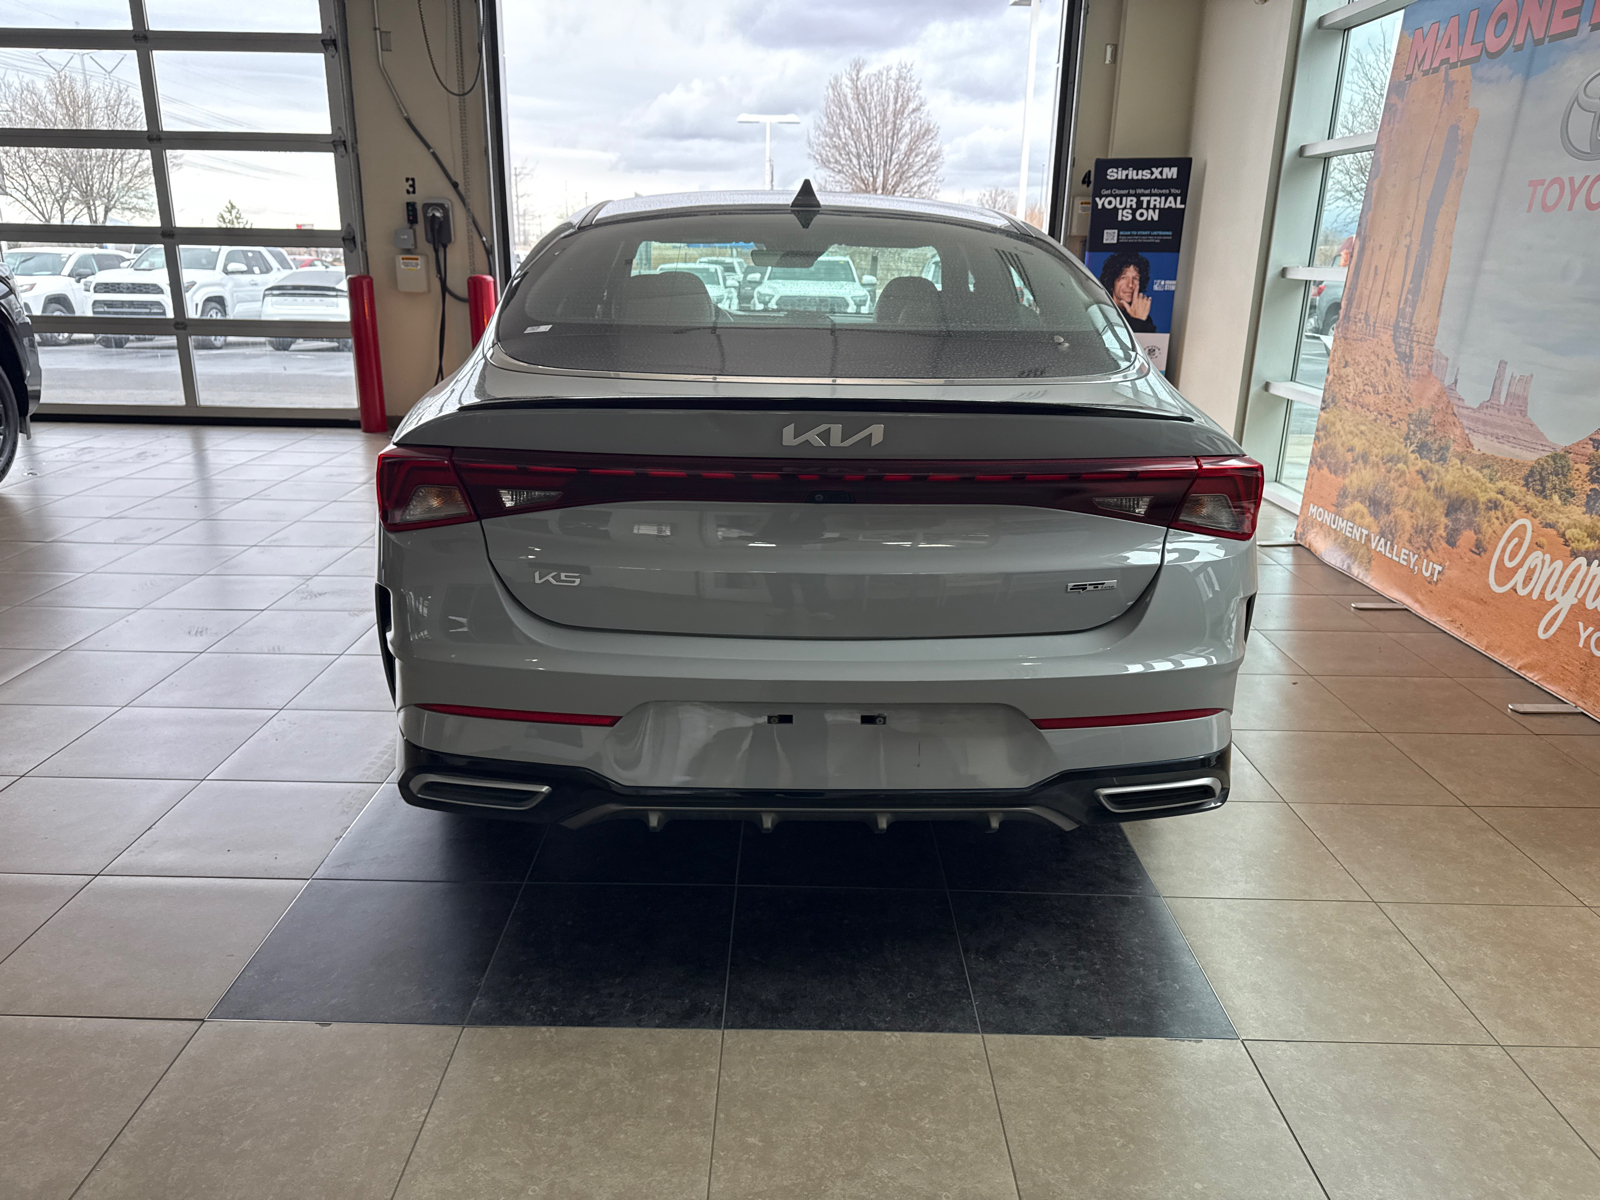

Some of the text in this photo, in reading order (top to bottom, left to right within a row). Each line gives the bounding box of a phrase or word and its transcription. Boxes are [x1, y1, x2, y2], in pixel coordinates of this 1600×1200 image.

[1404, 0, 1584, 80] MALONE
[1081, 169, 1092, 188] 4
[1106, 166, 1178, 180] SiriusXM
[405, 177, 416, 195] 3
[1095, 196, 1185, 209] YOUR TRIAL
[1117, 209, 1159, 221] IS ON
[1308, 503, 1443, 582] MONUMENT VALLEY, UT
[534, 571, 581, 586] K5
